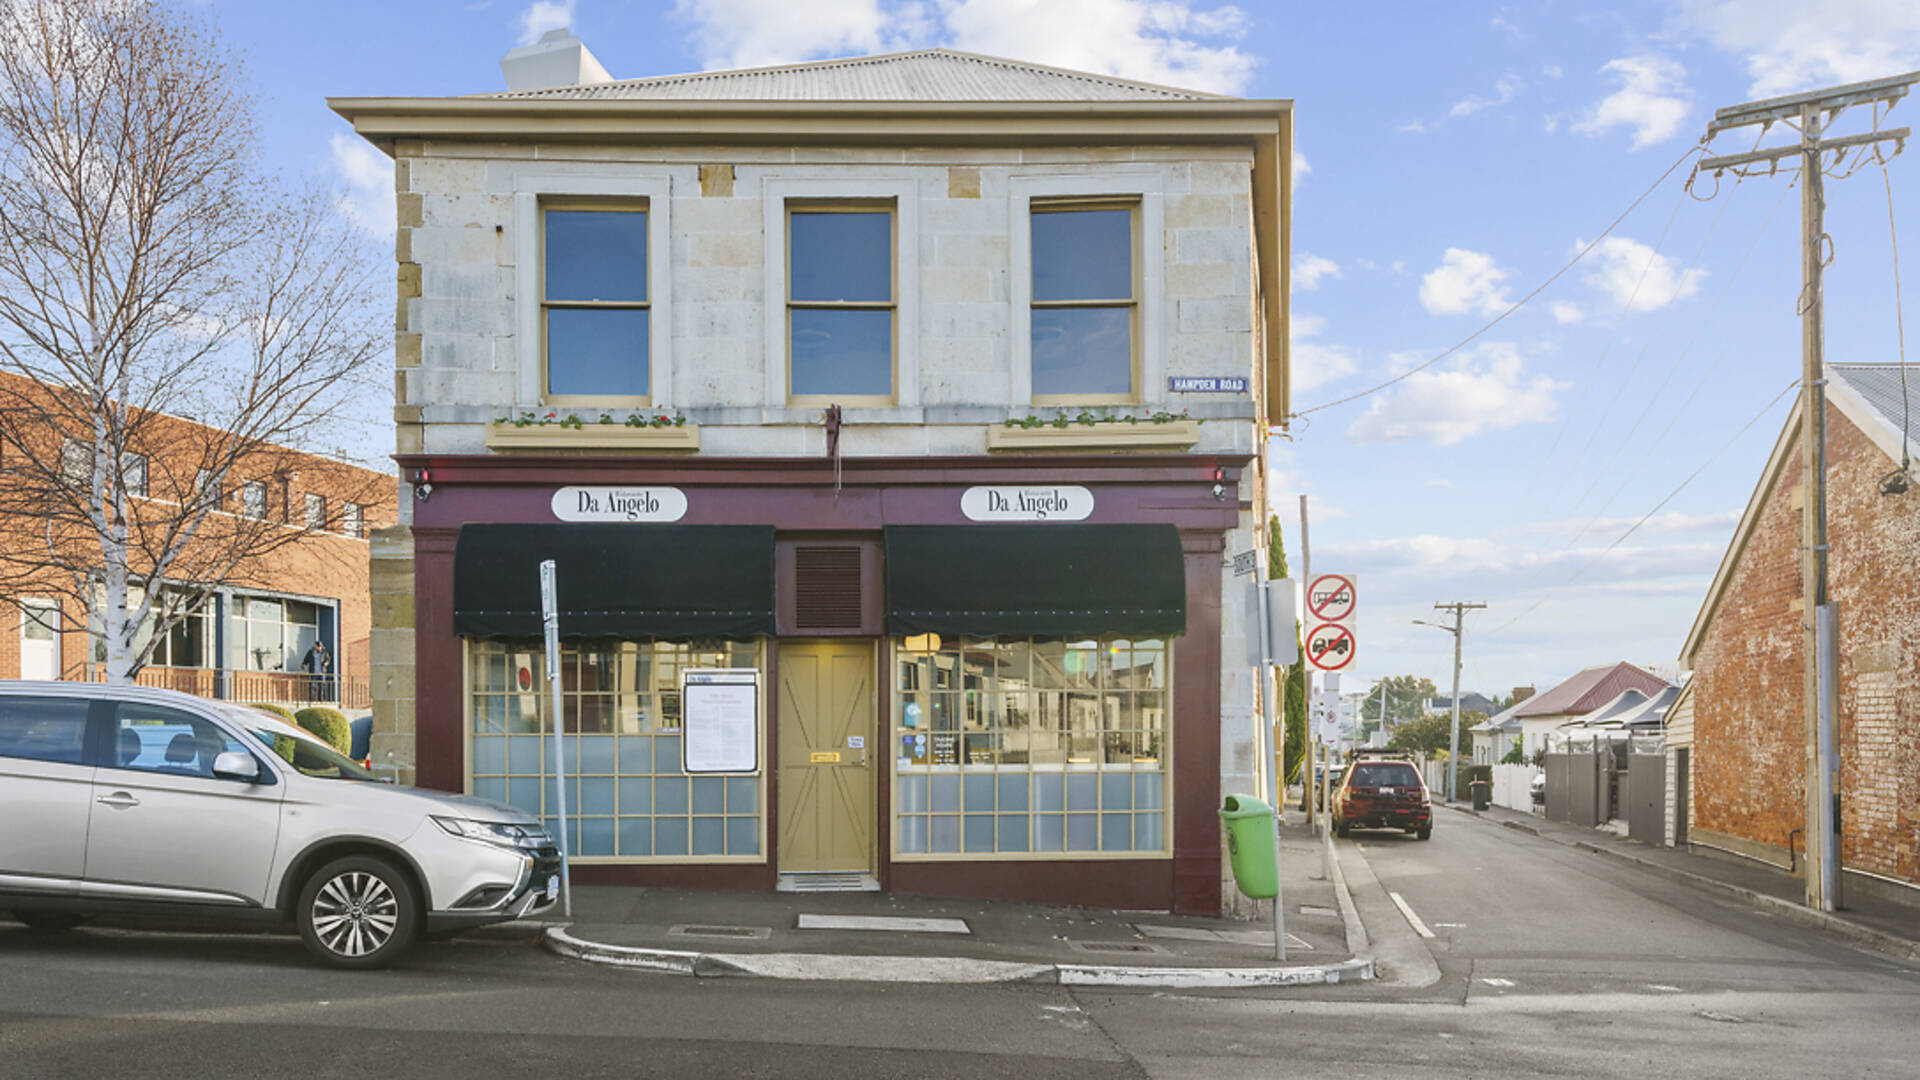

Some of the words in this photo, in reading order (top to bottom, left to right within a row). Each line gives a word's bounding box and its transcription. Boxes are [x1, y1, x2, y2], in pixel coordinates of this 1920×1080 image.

[1174, 379, 1216, 391] HAMPDEN
[1220, 379, 1244, 391] ROAD
[578, 491, 599, 513] Da
[604, 490, 660, 520] Angelo
[988, 490, 1009, 512] Da
[1014, 489, 1068, 519] Angelo
